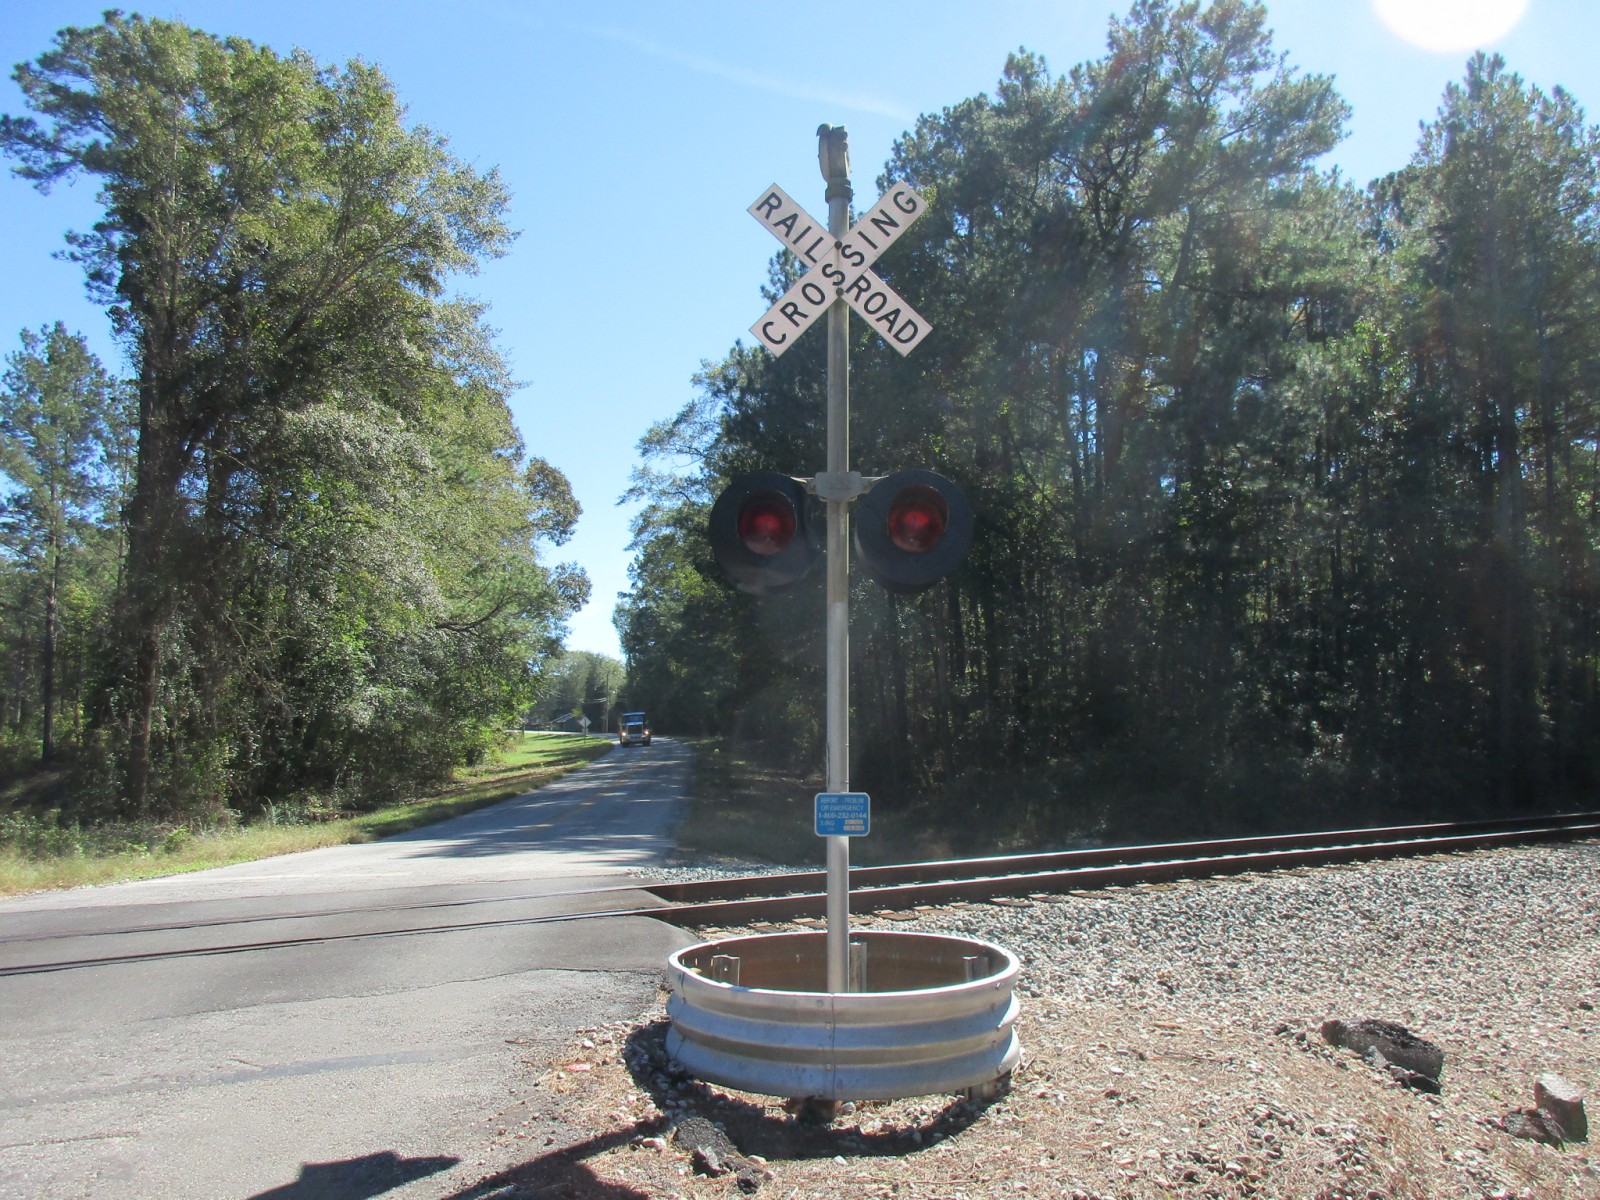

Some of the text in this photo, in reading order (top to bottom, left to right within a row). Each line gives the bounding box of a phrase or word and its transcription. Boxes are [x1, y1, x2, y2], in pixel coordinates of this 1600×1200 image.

[756, 192, 918, 344] RAIL ROAD
[762, 191, 917, 345] CROSSING
